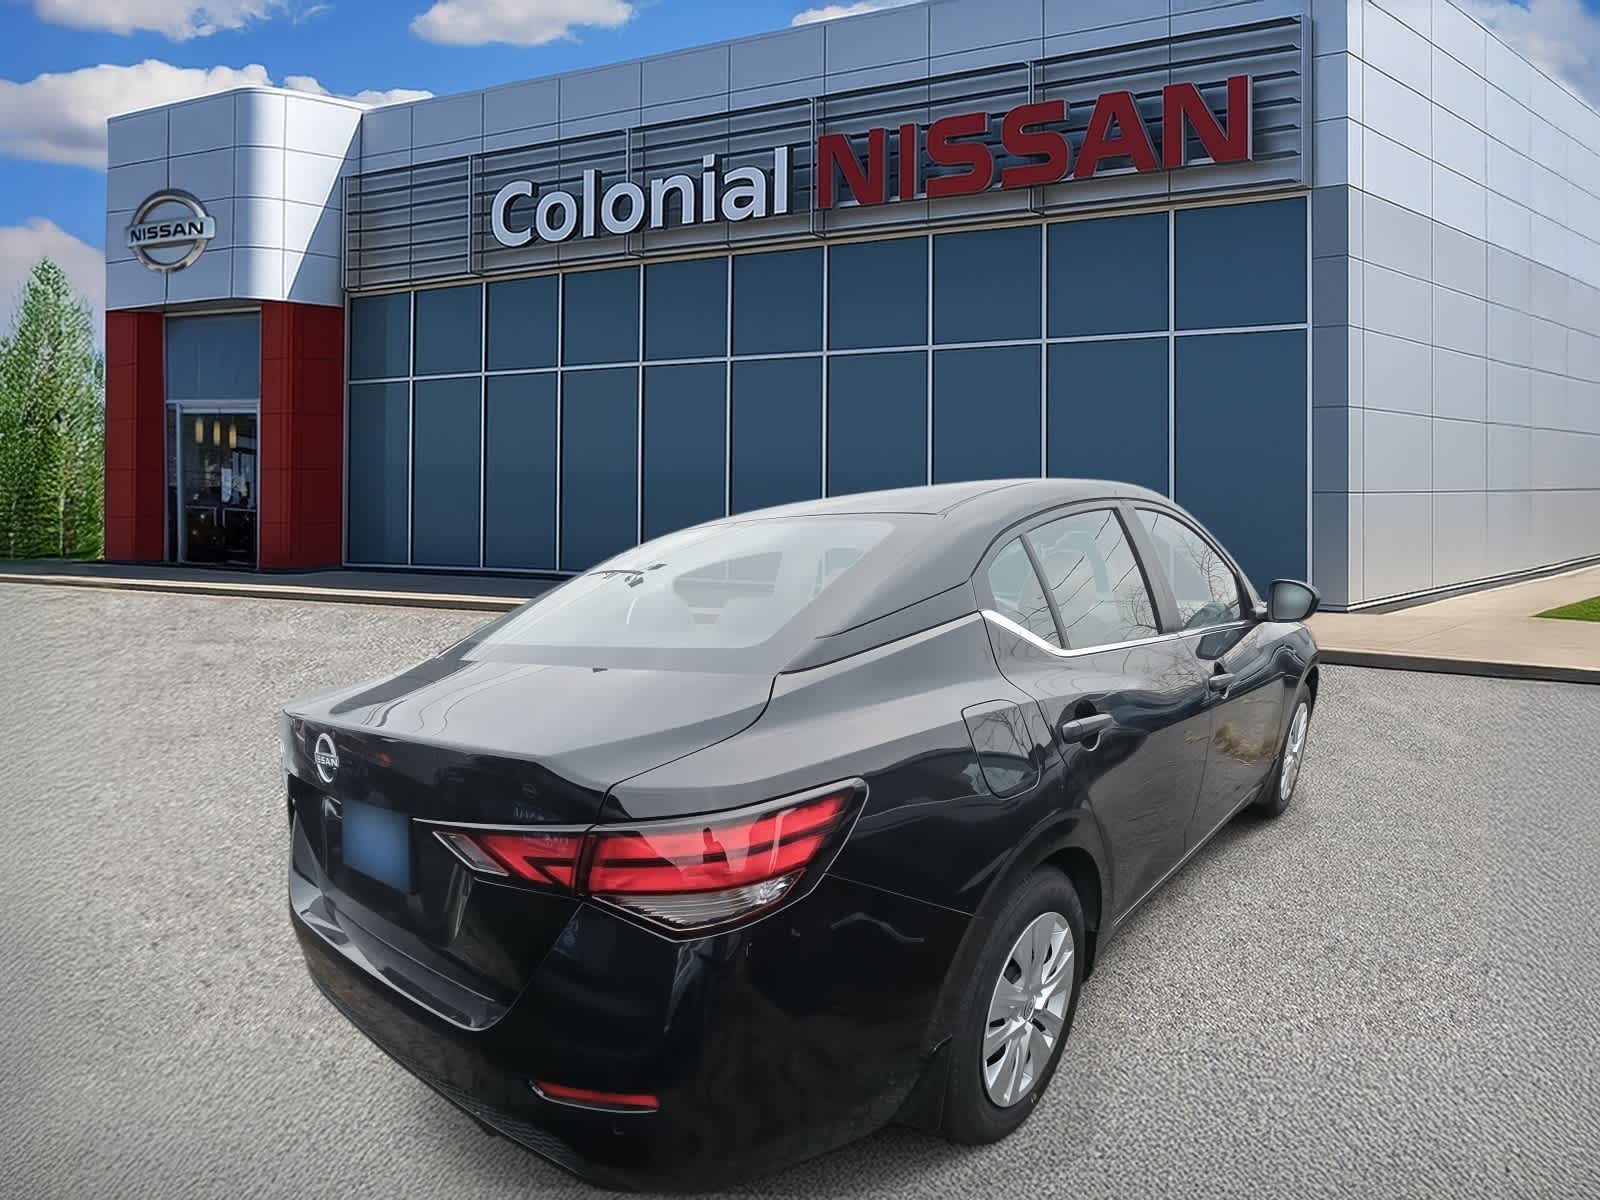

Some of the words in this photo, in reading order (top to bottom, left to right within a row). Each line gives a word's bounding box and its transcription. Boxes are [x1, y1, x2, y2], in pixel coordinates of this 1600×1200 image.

[491, 146, 790, 248] Colonial
[817, 75, 1252, 208] NISSAN
[130, 221, 204, 242] NISSAN
